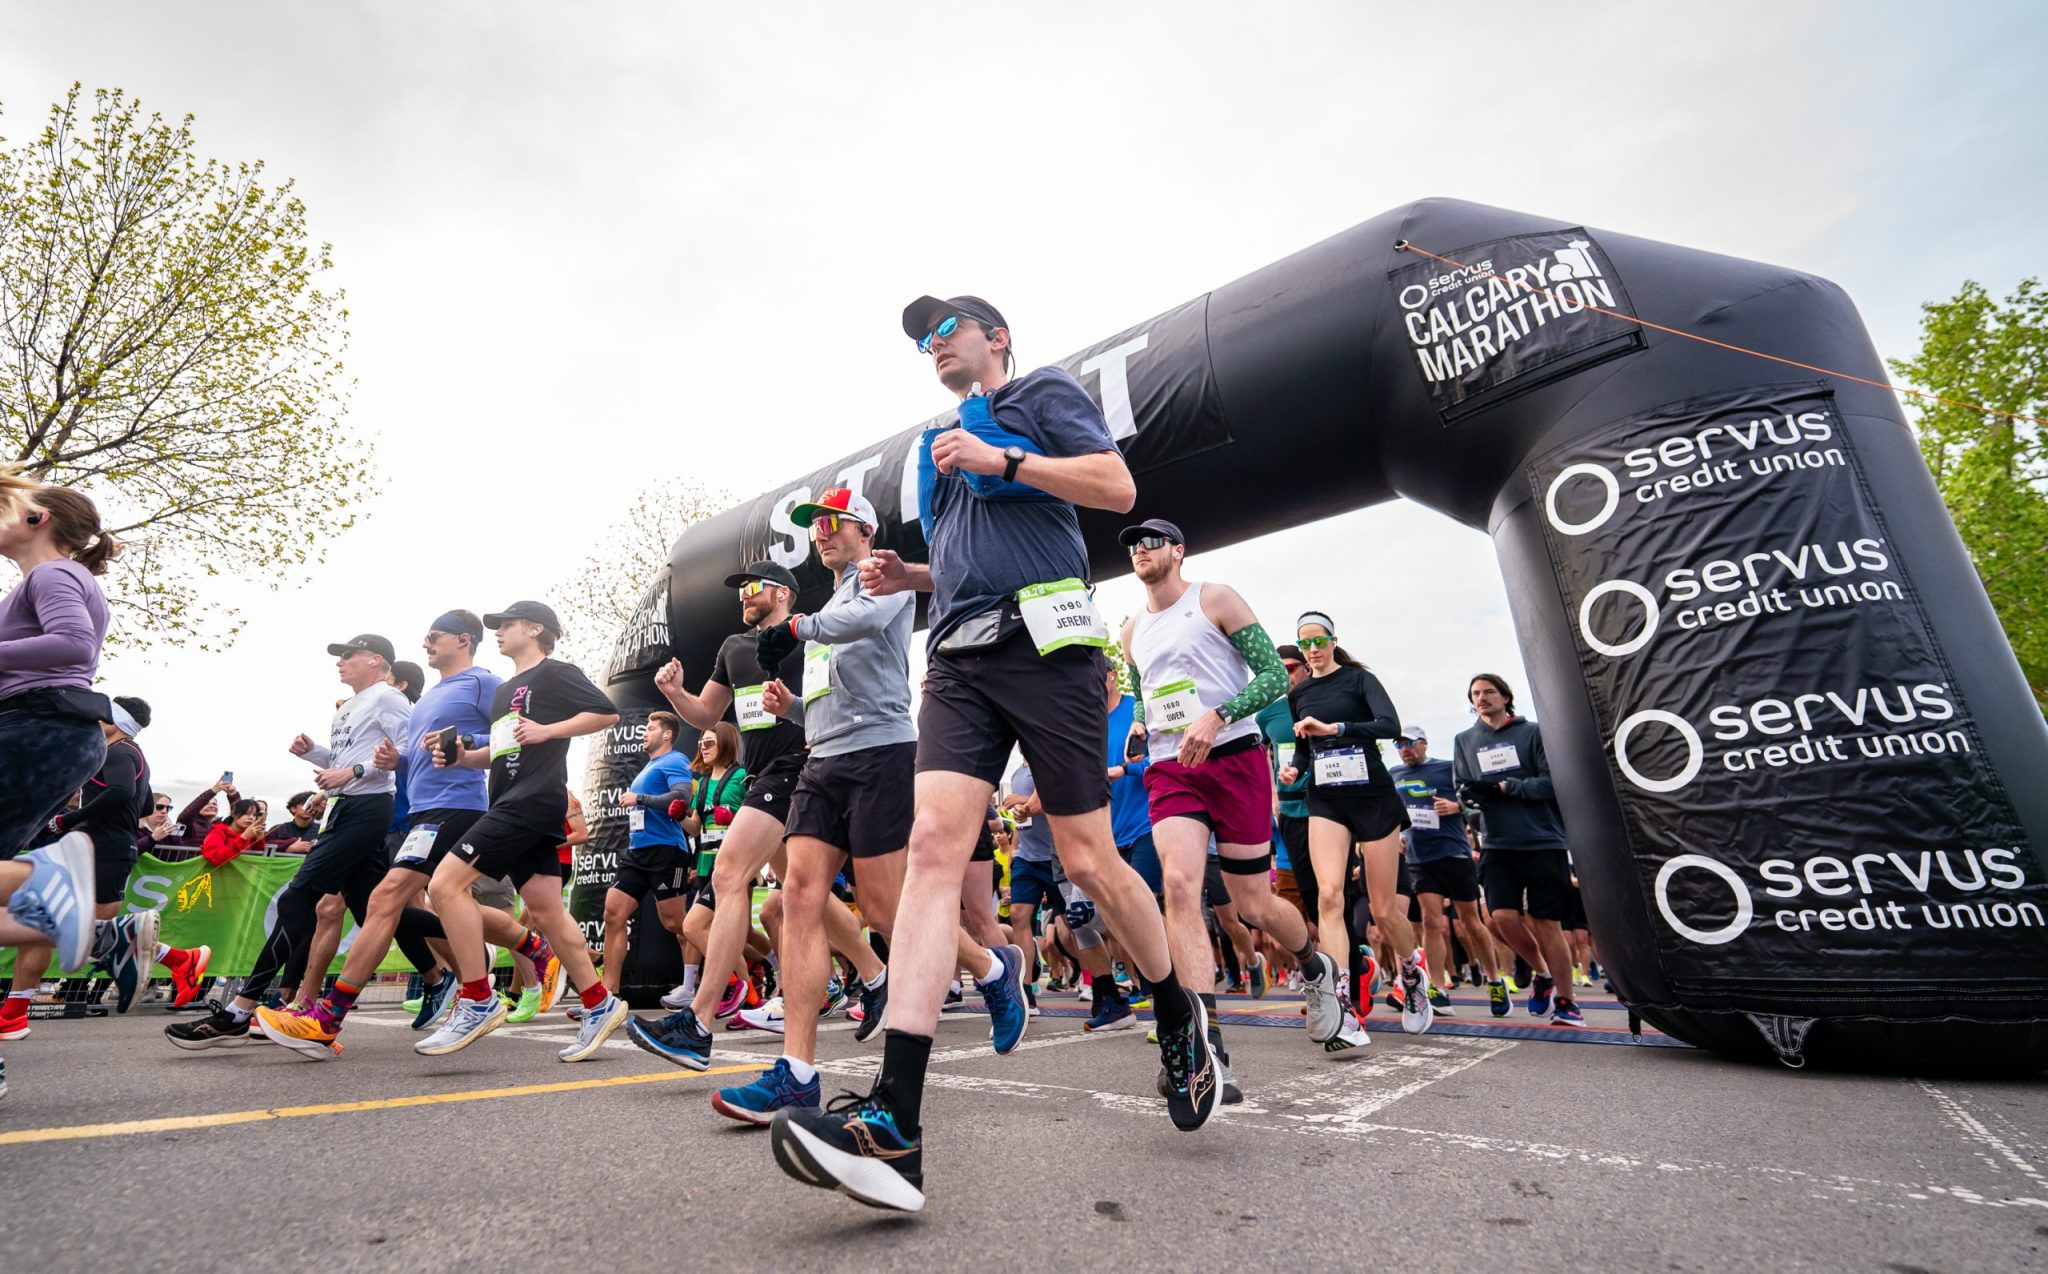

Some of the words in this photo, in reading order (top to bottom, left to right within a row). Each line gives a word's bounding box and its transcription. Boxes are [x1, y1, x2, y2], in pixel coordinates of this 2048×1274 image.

[1405, 257, 1548, 346] CALGARY
[1431, 280, 1463, 297] credit
[1465, 269, 1495, 285] union
[1416, 279, 1617, 382] MARATHON
[1624, 412, 1832, 478] servus
[1635, 460, 1742, 503] credit
[1749, 448, 1846, 476] union
[1665, 538, 1889, 602] servus
[1053, 600, 1082, 612] 1090
[1057, 615, 1092, 629] JEREMY
[1677, 588, 1792, 630] credit
[1801, 580, 1904, 607] union
[1163, 700, 1180, 710] 1680
[1167, 711, 1185, 722] OWEN
[1711, 683, 1953, 740] servus
[1722, 735, 1849, 772] credit
[1857, 730, 1971, 758] union
[1759, 848, 2026, 898] servus
[1775, 899, 1913, 932] credit
[1921, 902, 2046, 929] union
